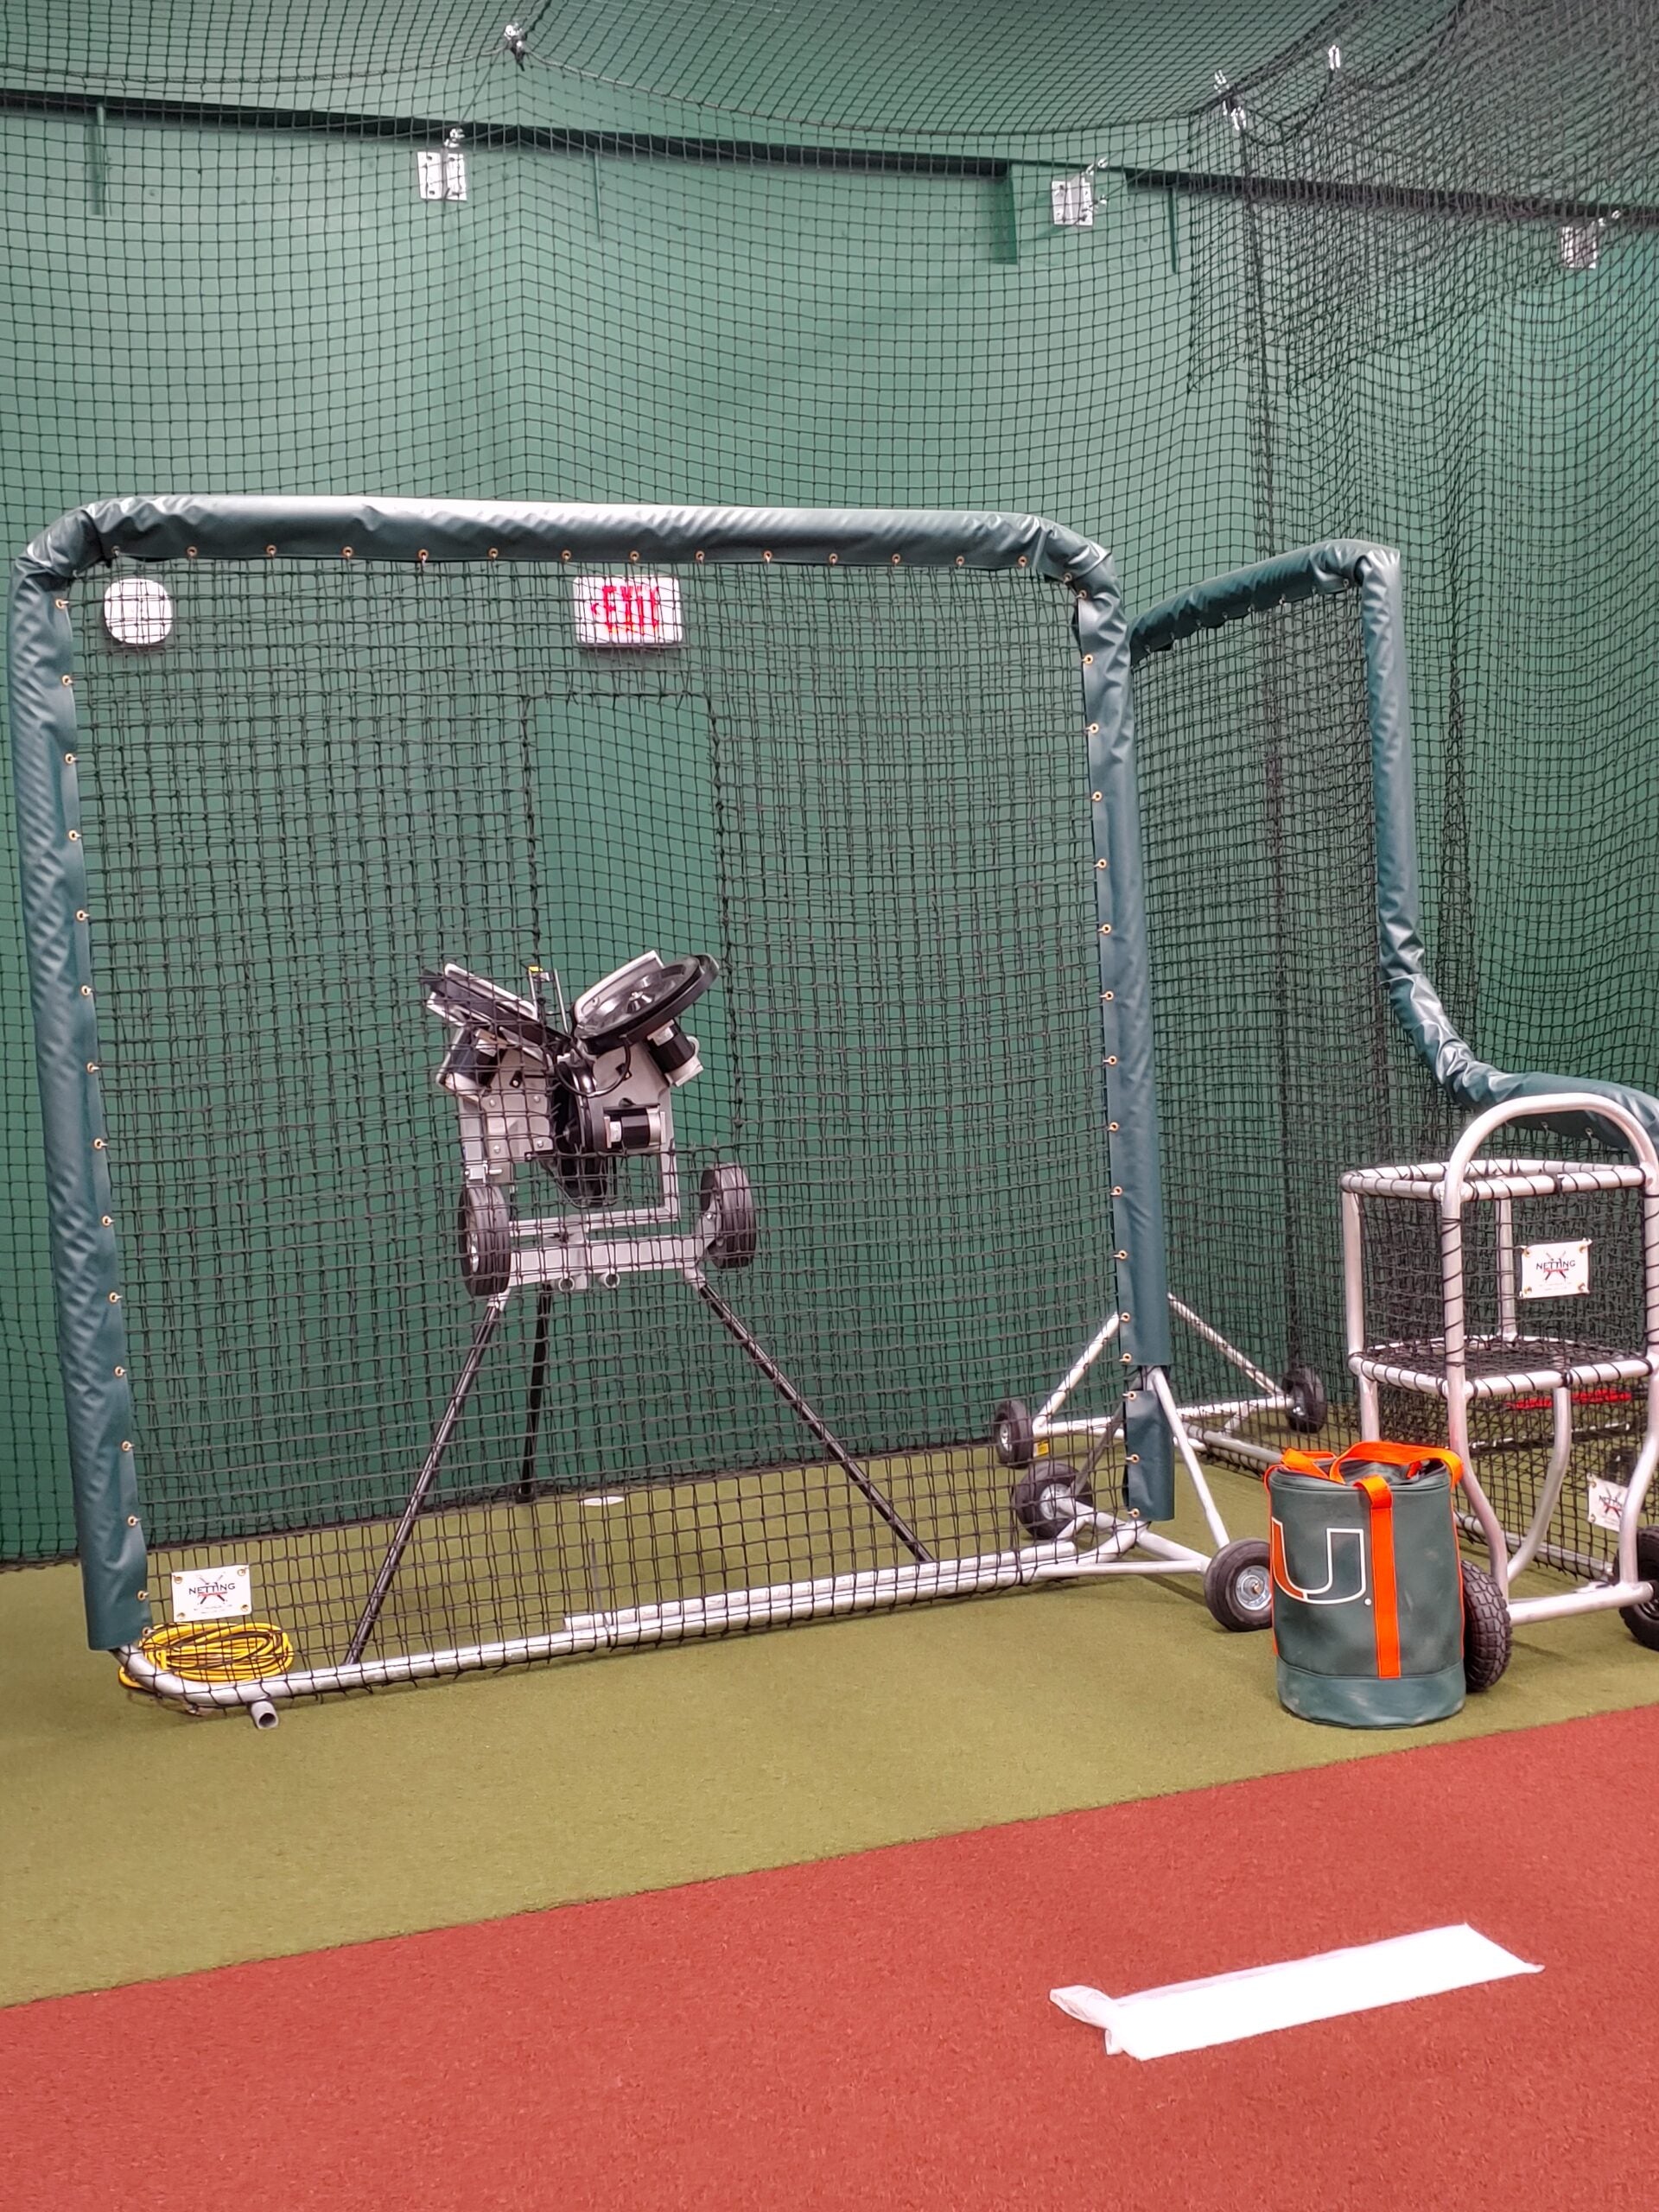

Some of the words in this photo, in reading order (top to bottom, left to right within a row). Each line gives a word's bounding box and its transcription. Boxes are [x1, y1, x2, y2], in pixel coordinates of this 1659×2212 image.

[1536, 1258, 1576, 1270] NETTING
[1271, 1516, 1367, 1605] U
[188, 1581, 236, 1595] NETTING
